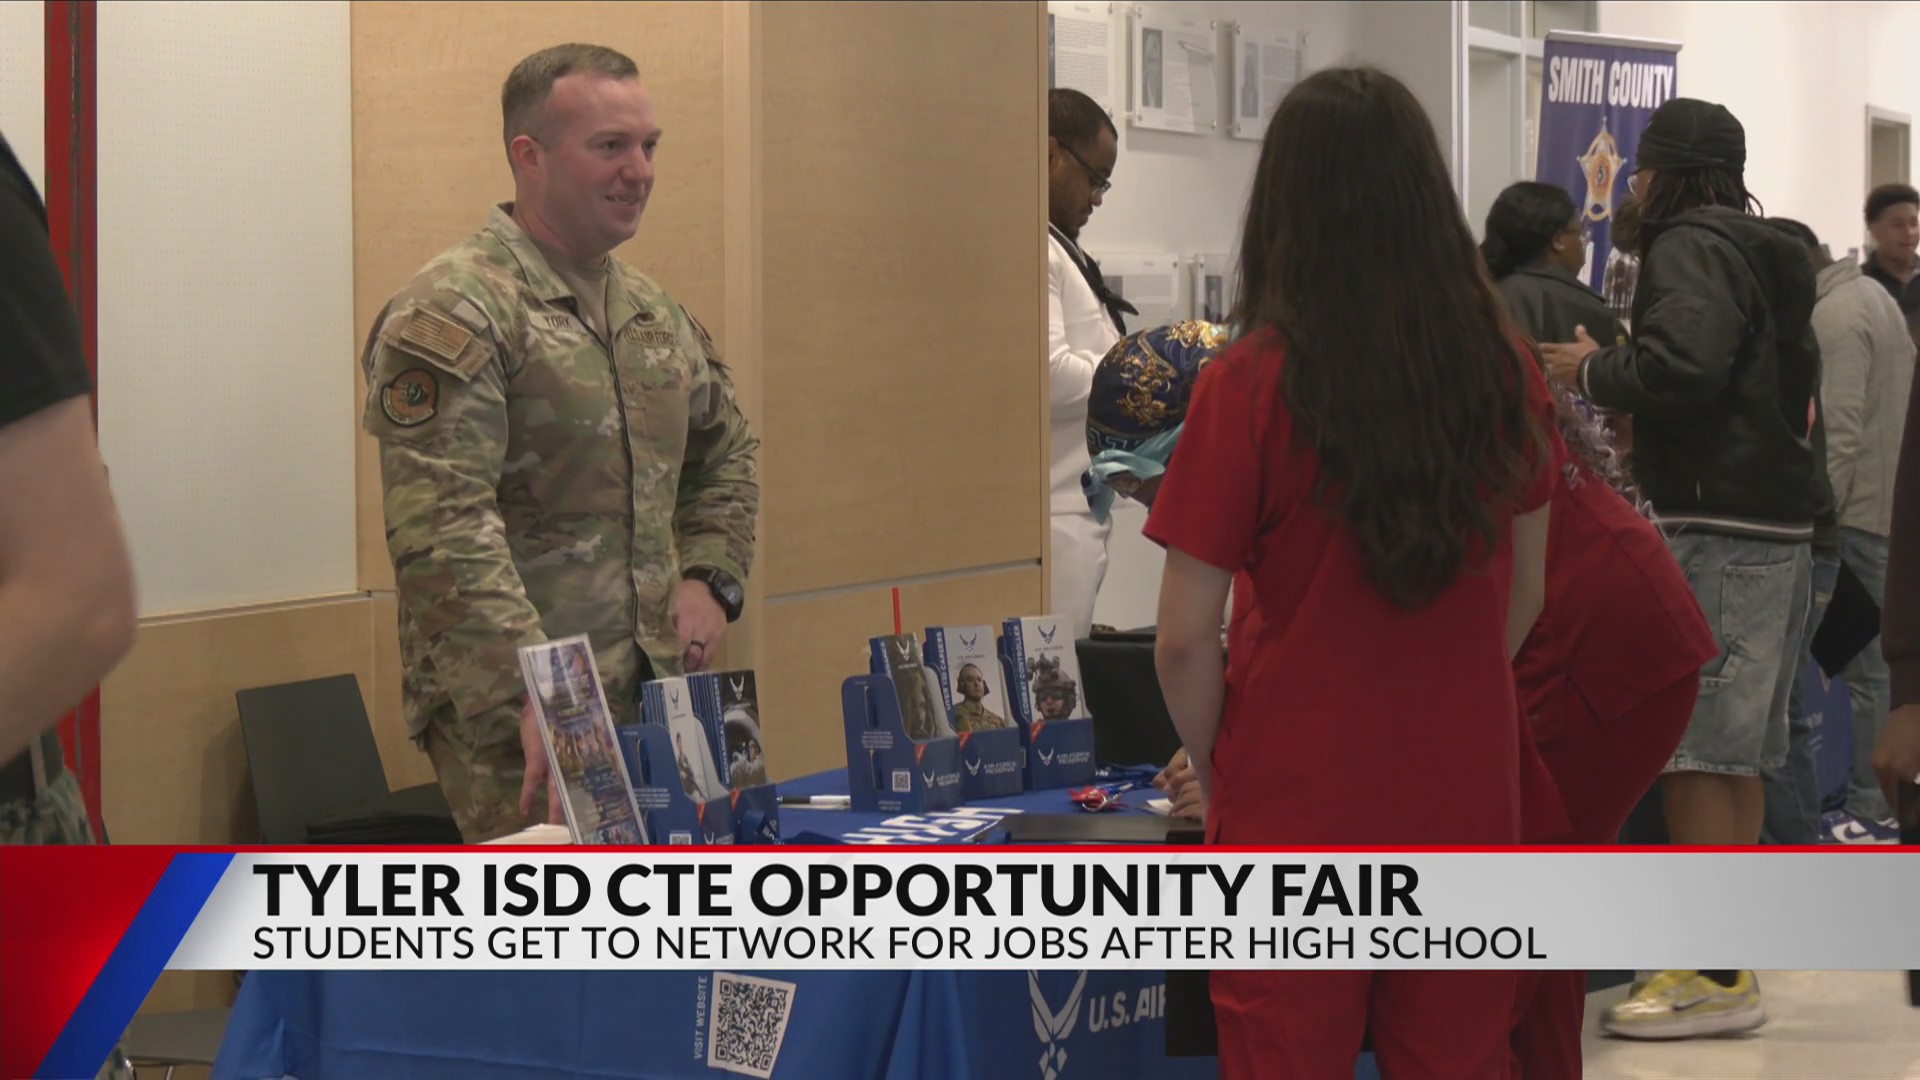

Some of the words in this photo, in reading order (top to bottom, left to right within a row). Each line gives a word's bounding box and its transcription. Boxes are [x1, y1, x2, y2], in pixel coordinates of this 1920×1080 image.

[1549, 56, 1605, 105] SMITH
[1608, 61, 1674, 109] COUNTY
[543, 315, 573, 330] YORK
[936, 631, 947, 670] CAREERS
[1013, 625, 1026, 679] CONTROLLER
[713, 676, 722, 721] CAREERS
[1019, 681, 1031, 714] COMBAT
[719, 723, 730, 785] MECHANICAL
[696, 975, 708, 1027] WEBSITE
[1088, 990, 1130, 1033] U.S.
[693, 1030, 704, 1060] VISIT
